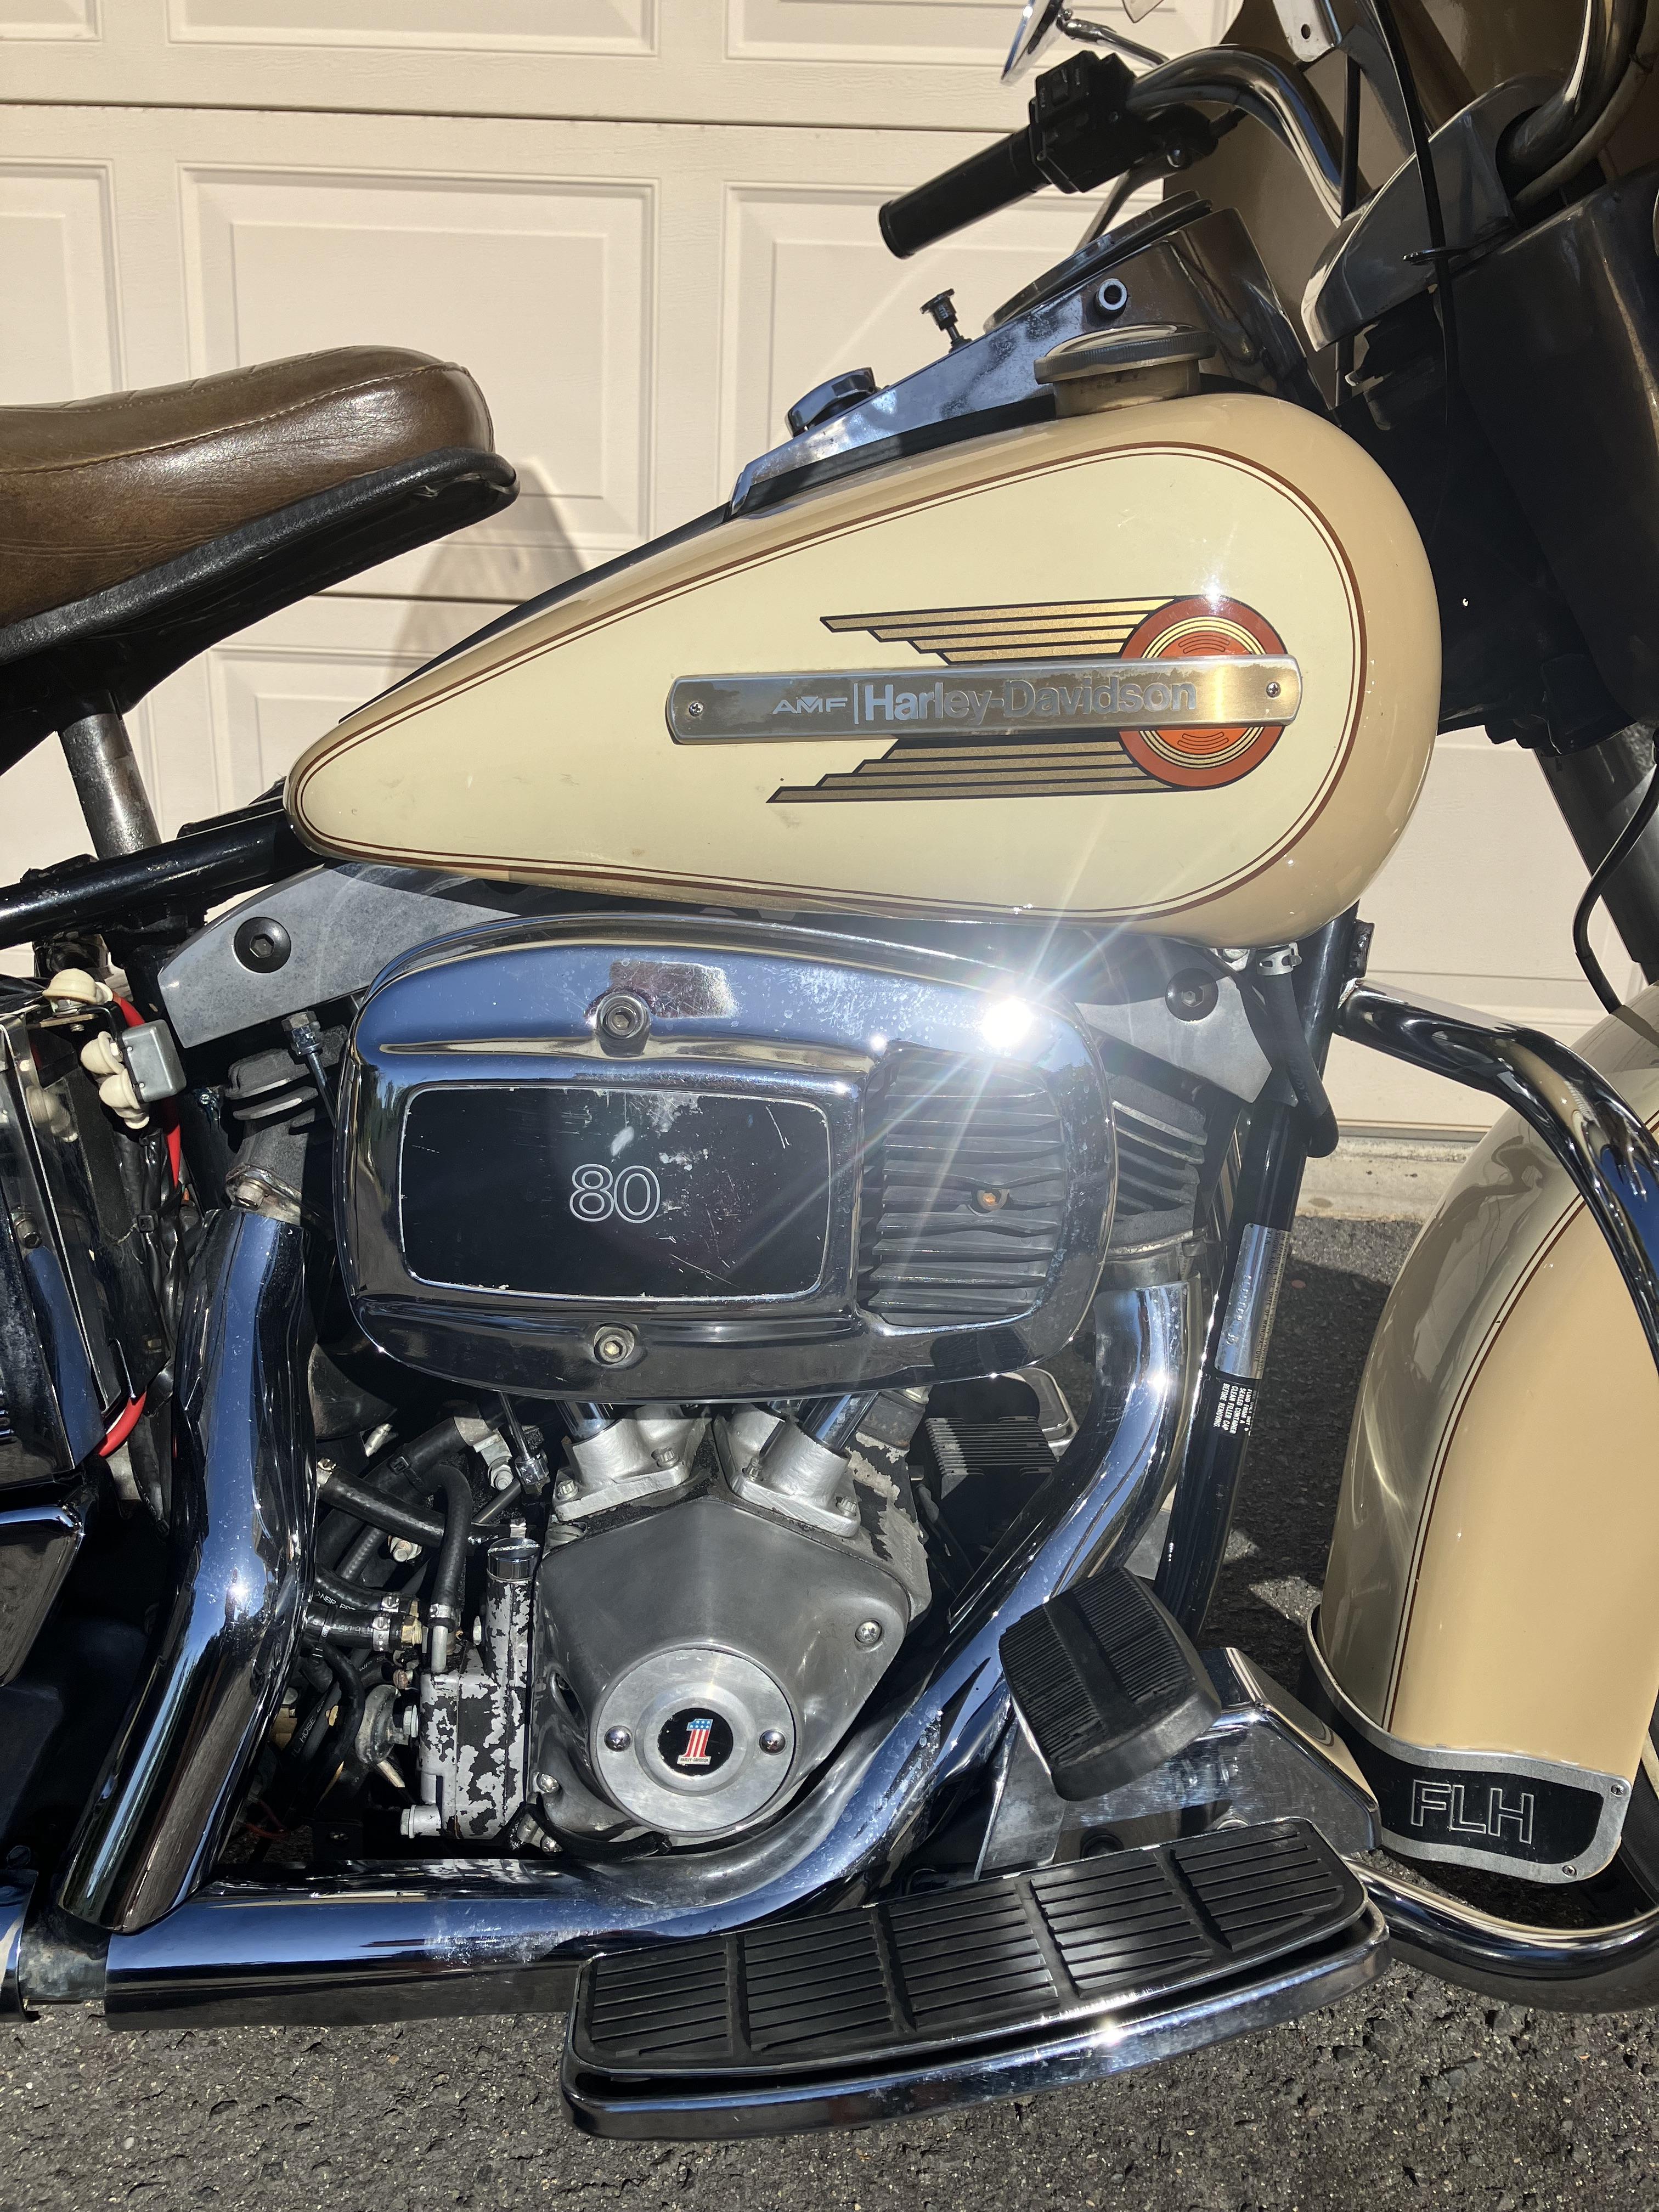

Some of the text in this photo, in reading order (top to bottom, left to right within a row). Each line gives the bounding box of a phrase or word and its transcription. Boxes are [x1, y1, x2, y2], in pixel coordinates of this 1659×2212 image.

[772, 676, 1197, 725] AMF Harley-Davidson
[569, 1163, 661, 1223] 80
[1272, 1232, 1280, 1254] SHOWN
[1276, 1243, 1284, 1263] EFFECT
[1273, 1266, 1279, 1274] ON
[1254, 1319, 1267, 1362] MANUFACTURE
[1214, 1383, 1230, 1427] BEFORE REMOVING.
[1222, 1386, 1238, 1430] CLEAN FILLER CAP
[1229, 1388, 1245, 1434] SEALED CONTAINER
[299, 1716, 316, 1743] HOSE
[1410, 1779, 1534, 1844] FLH
